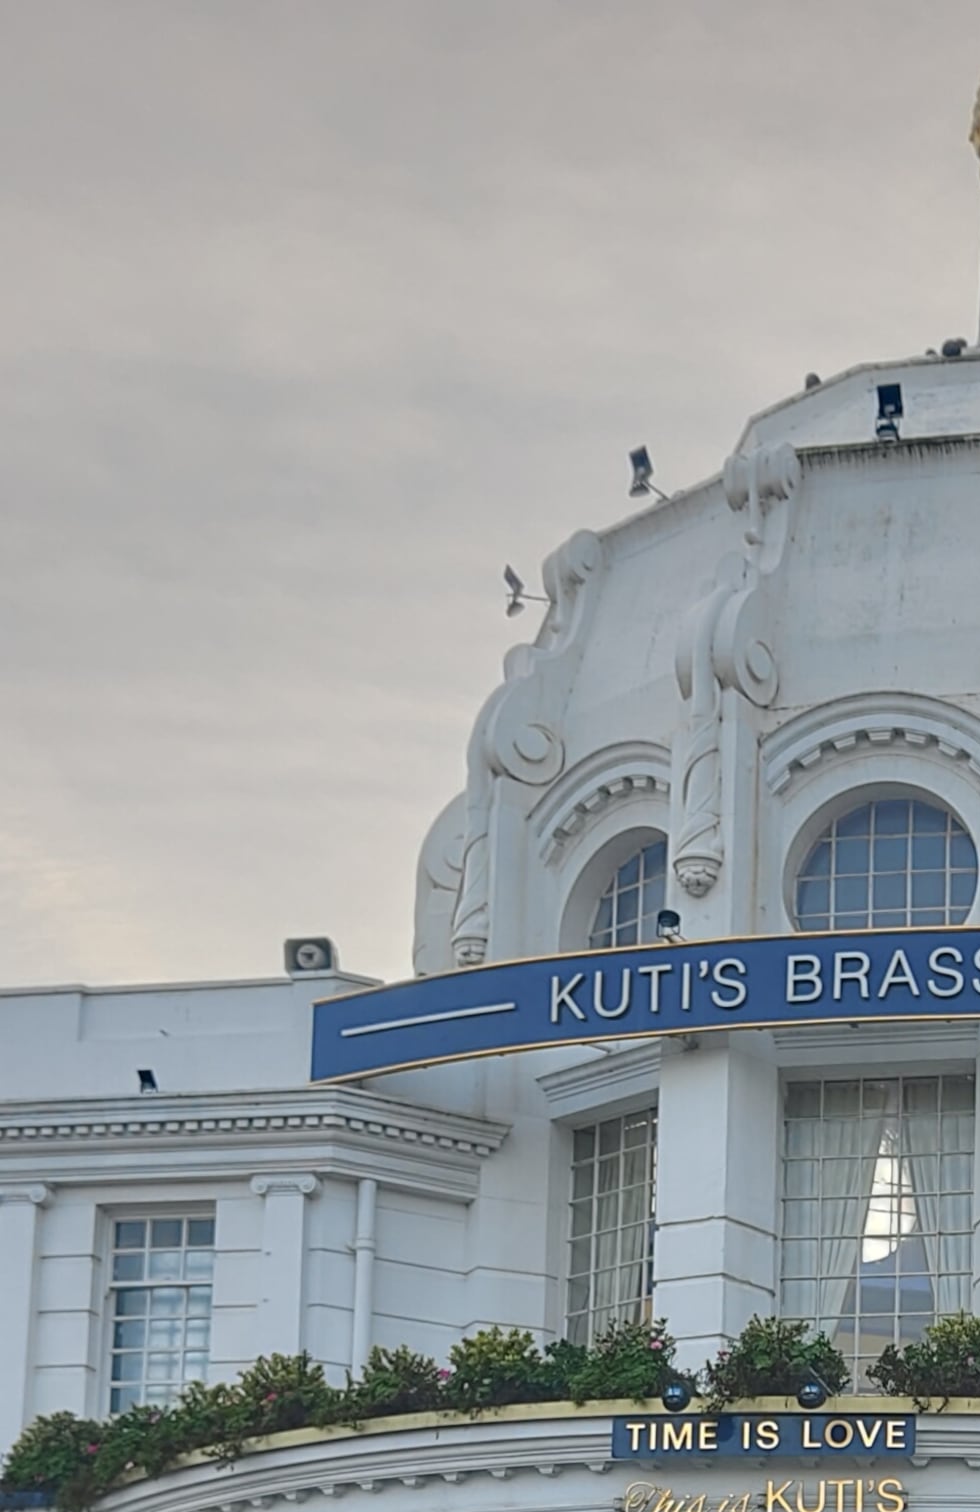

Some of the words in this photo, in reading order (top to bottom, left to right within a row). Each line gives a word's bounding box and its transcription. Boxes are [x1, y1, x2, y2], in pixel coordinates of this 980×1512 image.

[549, 957, 747, 1024] KUTI'S
[626, 1421, 719, 1451] TIME
[743, 1420, 780, 1450] IS
[803, 1418, 907, 1449] LOVE
